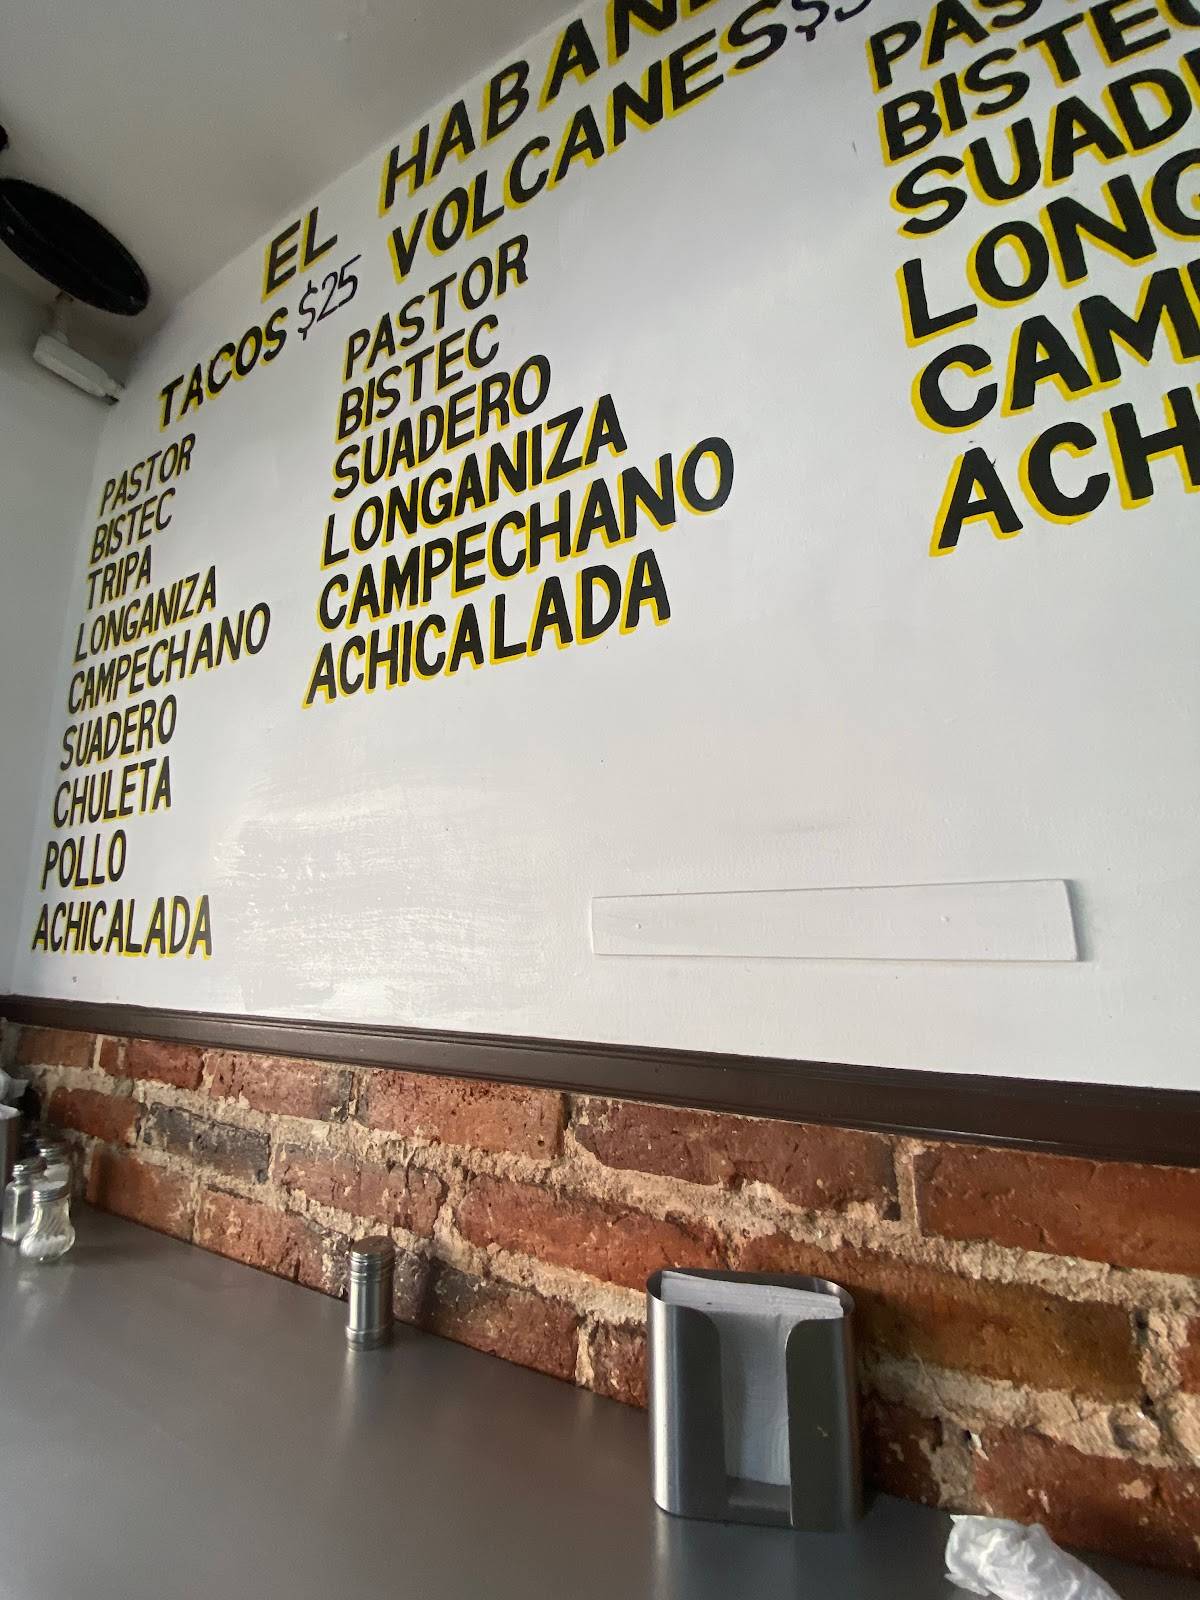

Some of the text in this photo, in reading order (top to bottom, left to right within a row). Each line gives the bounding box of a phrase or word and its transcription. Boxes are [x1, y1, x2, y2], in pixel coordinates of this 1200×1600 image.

[261, 0, 721, 302] EL HABAN
[388, 0, 787, 284] VOLCANES
[890, 46, 1200, 239] SUAD
[159, 254, 362, 430] TACOS $25
[342, 234, 529, 381] PASTOR
[911, 258, 1200, 435] CAM
[332, 354, 551, 502] SUADERO
[336, 314, 500, 444] BISTEC
[90, 488, 176, 565] BISTEC
[98, 433, 196, 517] PASTOR
[317, 437, 735, 631] CAMPECHANO
[320, 394, 628, 569] LONGANIZA
[73, 565, 217, 664] LONGANIZA
[87, 544, 152, 610] TRIPA
[302, 548, 672, 709] ACHICALADA
[69, 602, 271, 714] CAMPECHANO
[53, 756, 172, 828] CHULETA
[60, 694, 177, 771] SUADERO
[32, 895, 214, 960] ACHICALADA
[41, 829, 127, 890] POLLO
